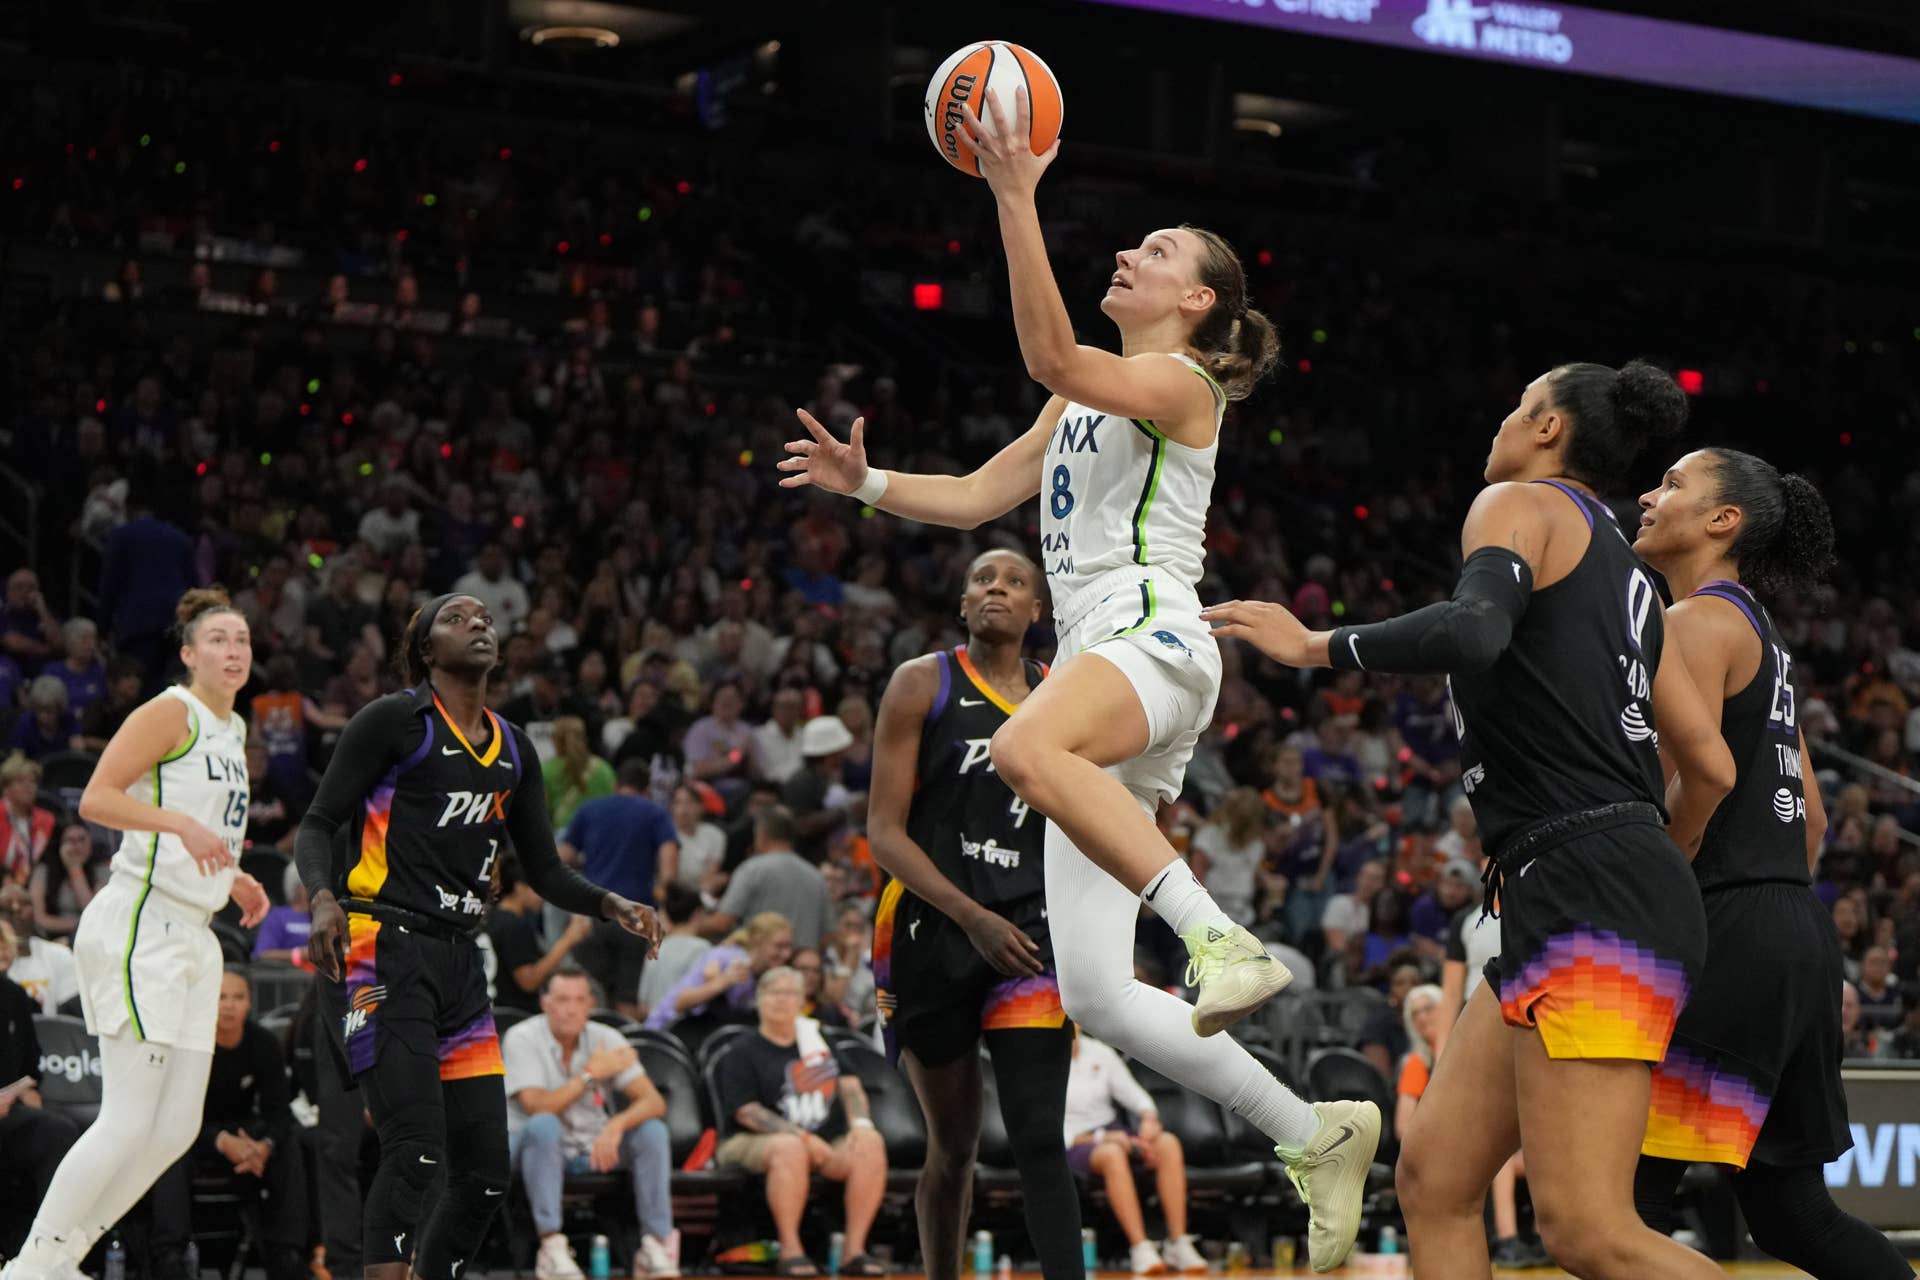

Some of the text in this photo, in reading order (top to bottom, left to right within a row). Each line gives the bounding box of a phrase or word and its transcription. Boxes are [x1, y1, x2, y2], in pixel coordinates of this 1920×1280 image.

[1480, 23, 1573, 64] METRO
[944, 73, 977, 160] Wilson
[1050, 464, 1075, 520] 8
[1626, 566, 1653, 651] 0
[1768, 643, 1796, 730] 25
[958, 738, 996, 774] P
[223, 790, 248, 828] 15
[437, 789, 511, 827] PHX
[1009, 796, 1030, 829] 4
[478, 839, 498, 882] 2
